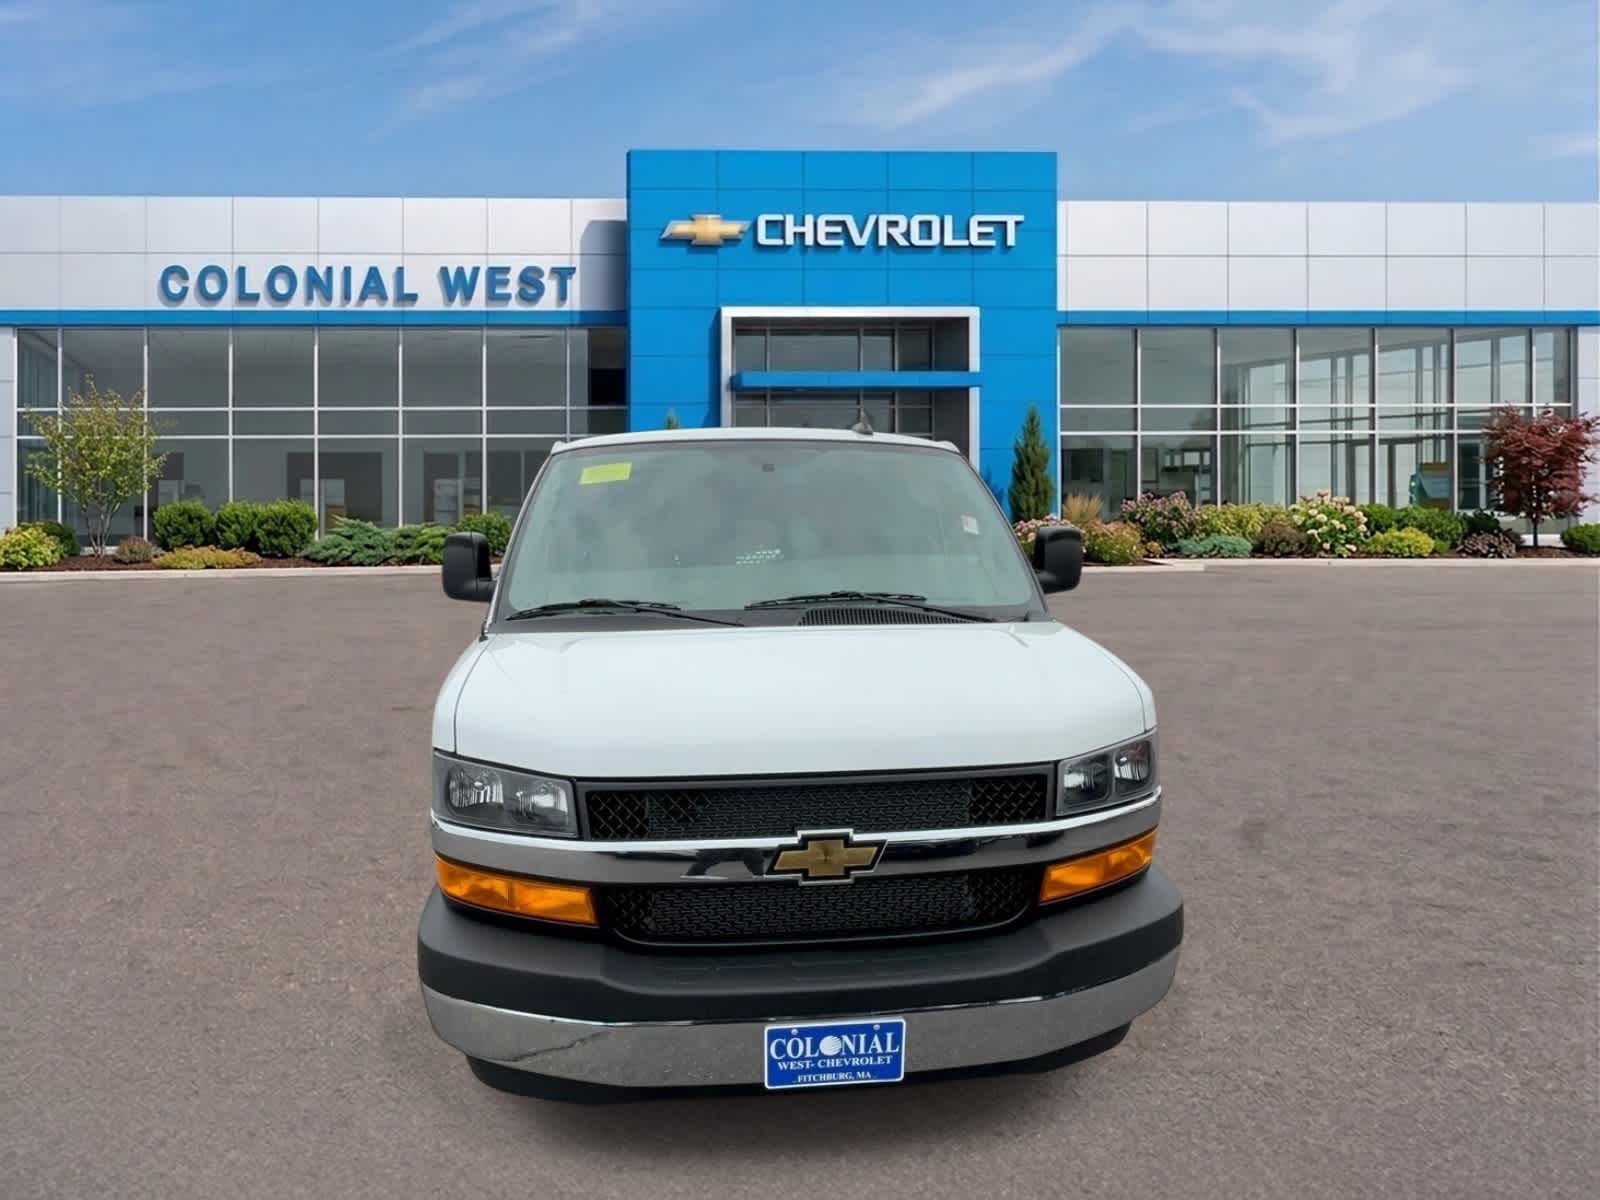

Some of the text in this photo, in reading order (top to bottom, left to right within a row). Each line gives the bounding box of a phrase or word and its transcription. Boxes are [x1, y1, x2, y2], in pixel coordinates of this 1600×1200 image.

[757, 213, 1025, 247] CHEVROLET
[159, 264, 577, 303] COLONIAL WEST
[817, 1055, 893, 1068] CHEVROLET
[856, 1071, 872, 1080] MA
